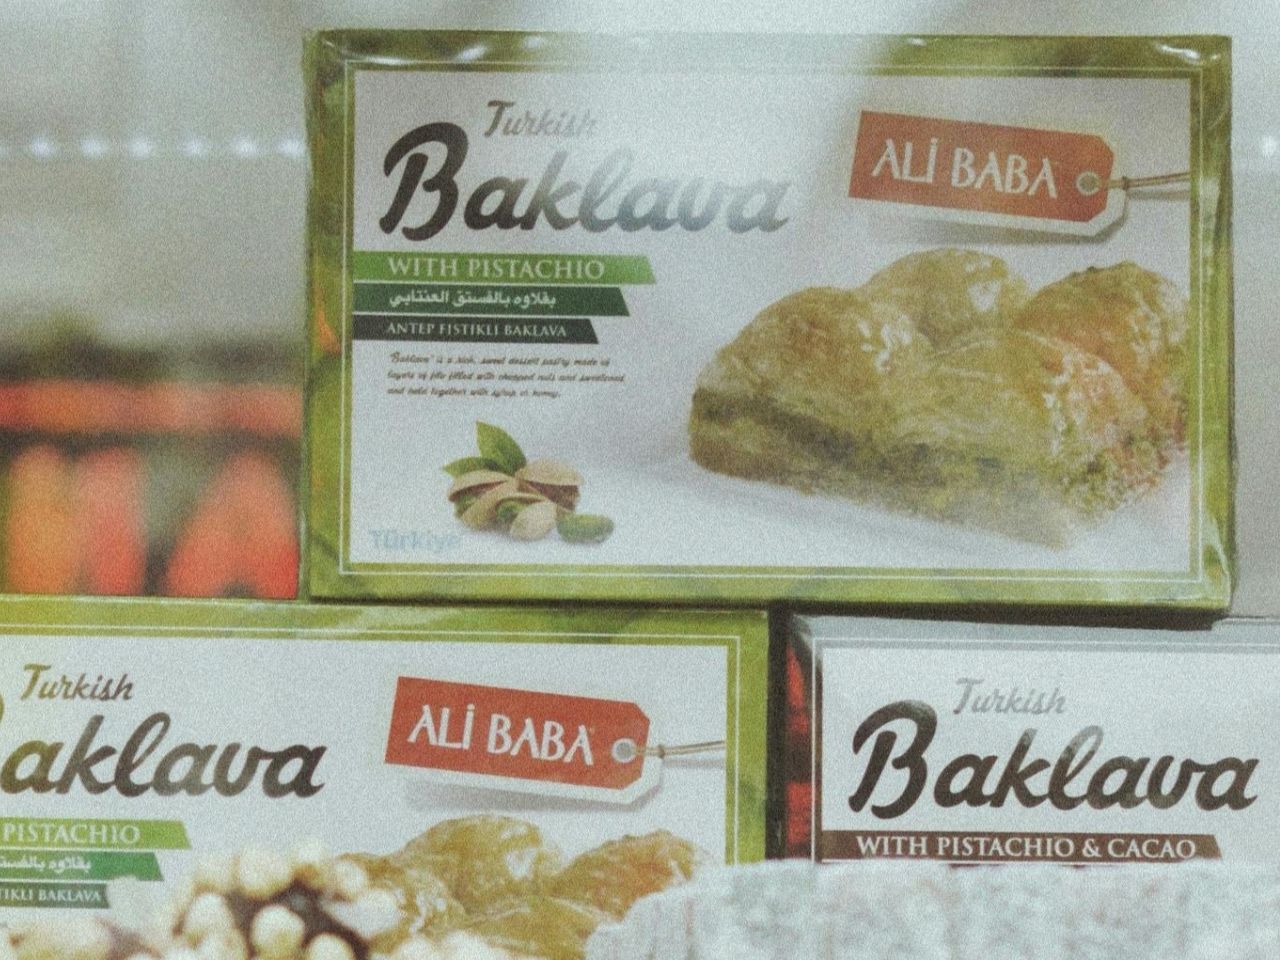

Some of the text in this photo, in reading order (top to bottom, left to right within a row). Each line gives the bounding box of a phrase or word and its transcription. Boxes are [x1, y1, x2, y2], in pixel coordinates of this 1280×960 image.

[484, 99, 598, 138] Turkish
[378, 122, 791, 242] Baklava
[950, 147, 1058, 199] BABA
[387, 256, 606, 281] WITH PISTACHIO
[386, 321, 435, 335] ANTEP
[504, 324, 567, 337] BAKLAVA
[20, 662, 135, 702] Turkish
[952, 676, 1068, 716] Turkish
[486, 712, 594, 767] BABA
[848, 699, 1260, 820] Baklava
[2, 823, 142, 844] PISTACHIO
[855, 835, 1196, 860] WITH PISTACHIO & CACAO
[39, 889, 102, 902] BAKLAVA
